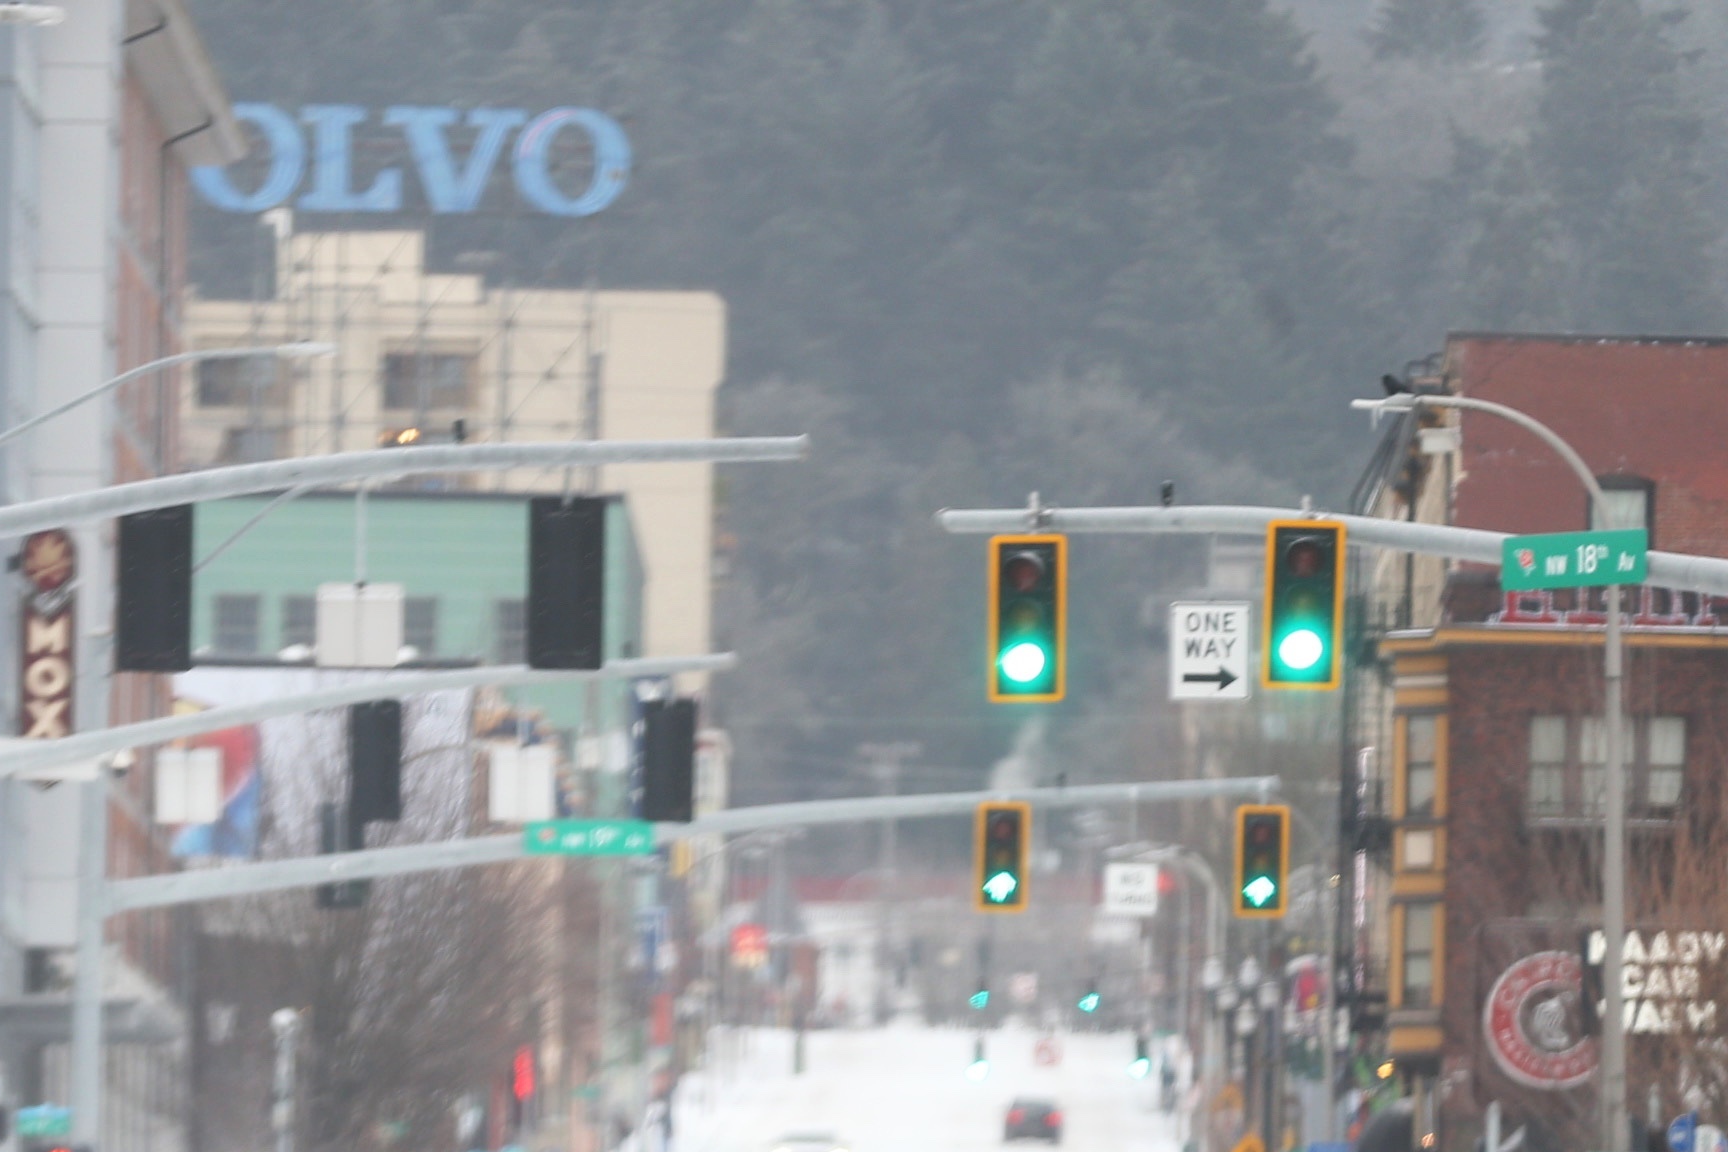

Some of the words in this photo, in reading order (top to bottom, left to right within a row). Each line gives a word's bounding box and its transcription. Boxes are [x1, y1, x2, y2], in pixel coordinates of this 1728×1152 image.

[1545, 555, 1568, 576] NW
[1575, 544, 1609, 574] 18th
[1617, 551, 1636, 572] Av
[1186, 612, 1237, 633] ONE
[1185, 637, 1239, 658] WAY
[24, 616, 70, 738] MOX
